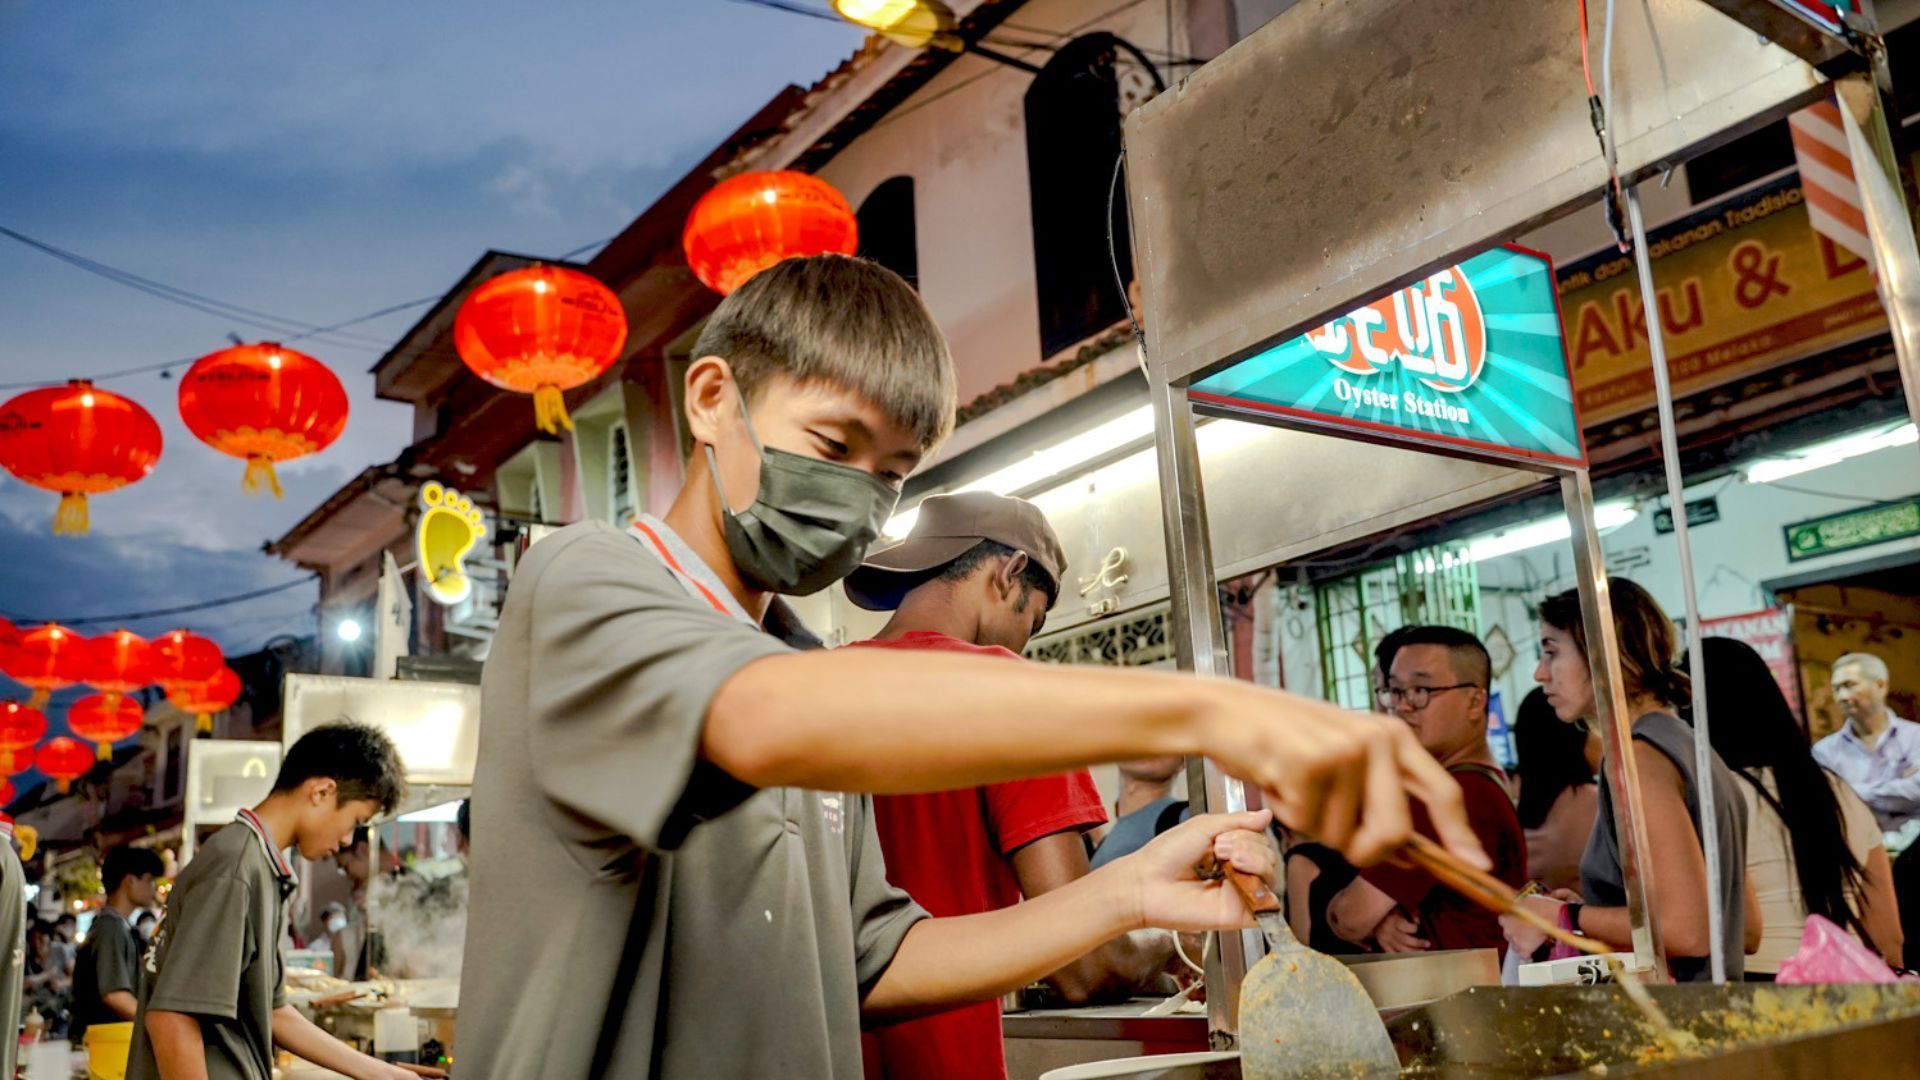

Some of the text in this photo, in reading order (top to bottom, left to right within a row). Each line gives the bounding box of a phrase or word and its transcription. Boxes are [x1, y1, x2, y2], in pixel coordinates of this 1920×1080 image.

[1558, 188, 1804, 296] ntik dan akanan Tradisio
[1573, 278, 1705, 371] Aku
[1730, 242, 1792, 309] &
[1334, 378, 1469, 423] Oyster Station
[1700, 614, 1787, 640] AKANAN
